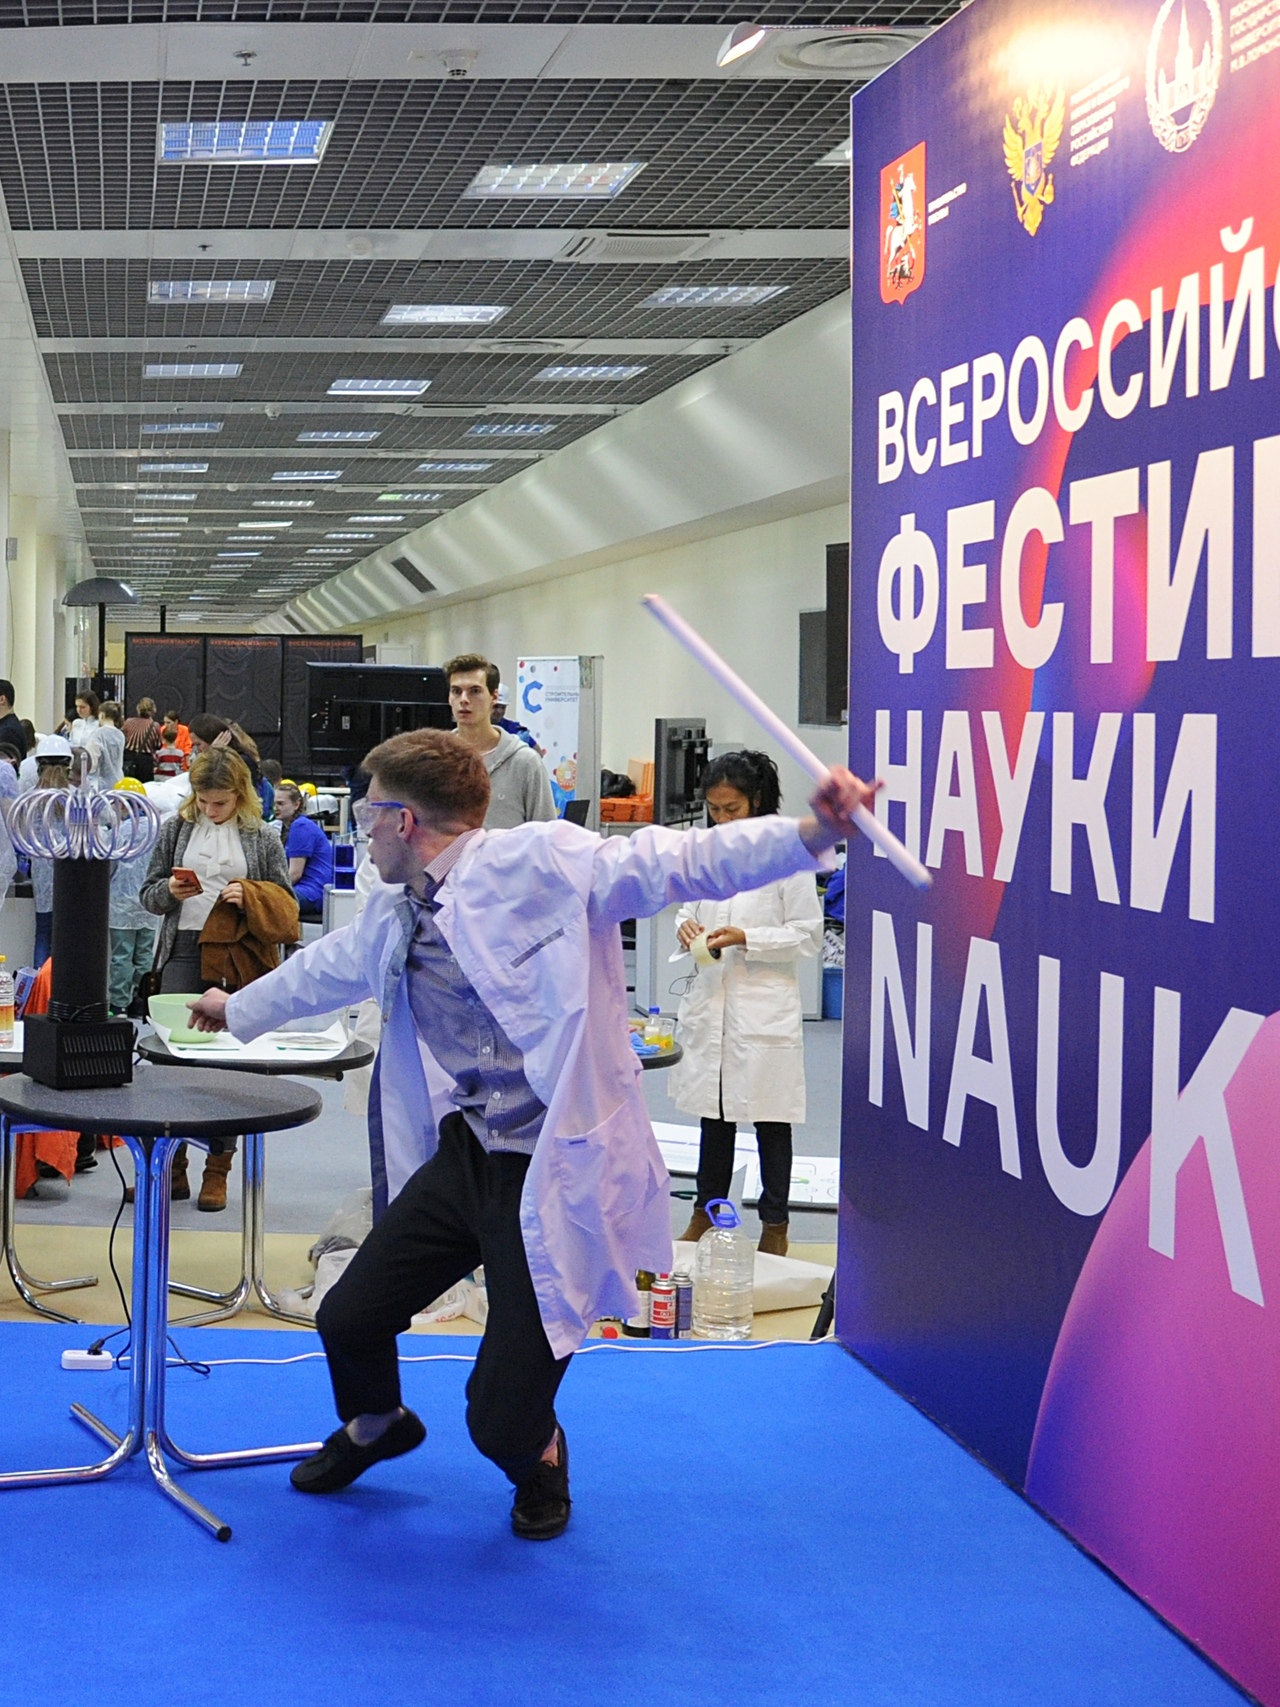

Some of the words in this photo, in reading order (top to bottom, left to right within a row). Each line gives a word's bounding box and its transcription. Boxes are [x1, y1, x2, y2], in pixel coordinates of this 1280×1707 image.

[877, 216, 1280, 485] ВСЕРОССИЙ
[873, 710, 1218, 924] НАУКИ
[869, 909, 1267, 1307] NAUK
